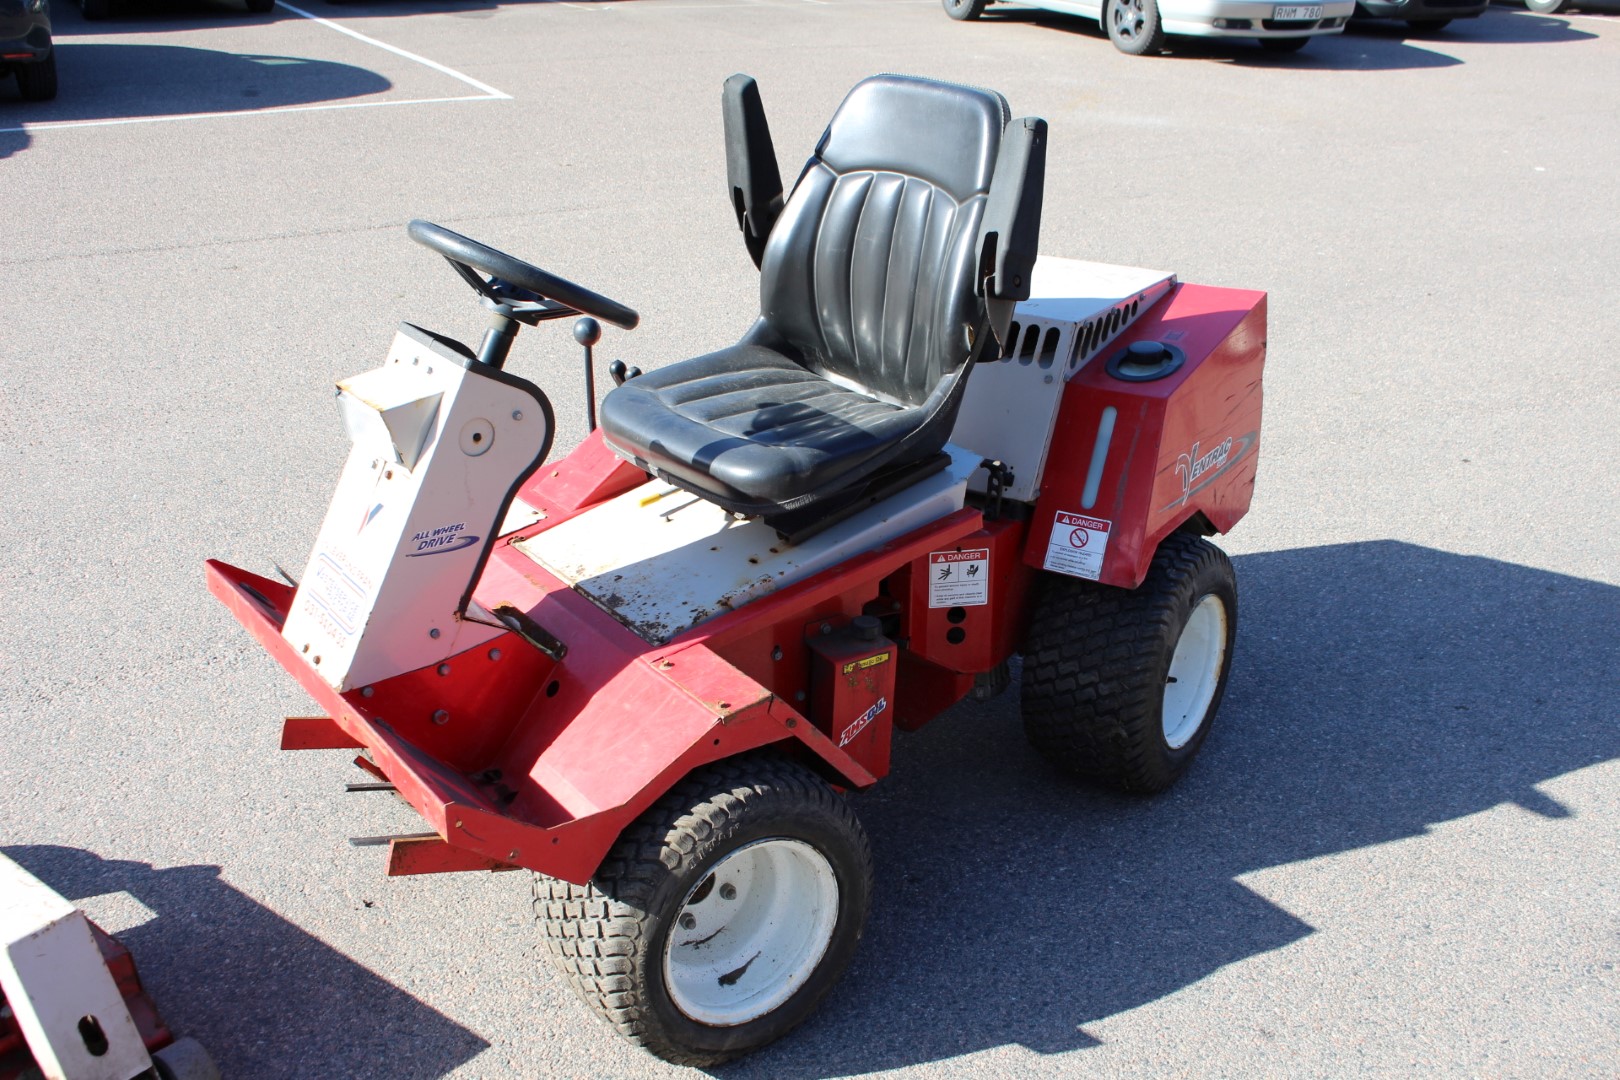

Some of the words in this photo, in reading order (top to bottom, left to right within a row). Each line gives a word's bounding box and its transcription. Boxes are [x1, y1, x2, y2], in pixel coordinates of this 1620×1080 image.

[1303, 7, 1321, 18] 780
[1175, 436, 1232, 506] VENTRAC
[411, 531, 430, 541] ALL
[432, 522, 465, 536] WHEEL
[1071, 517, 1103, 530] DANGER
[417, 533, 456, 551] DRIVE
[947, 552, 981, 561] DANGER
[839, 696, 887, 747] AMSOIL
